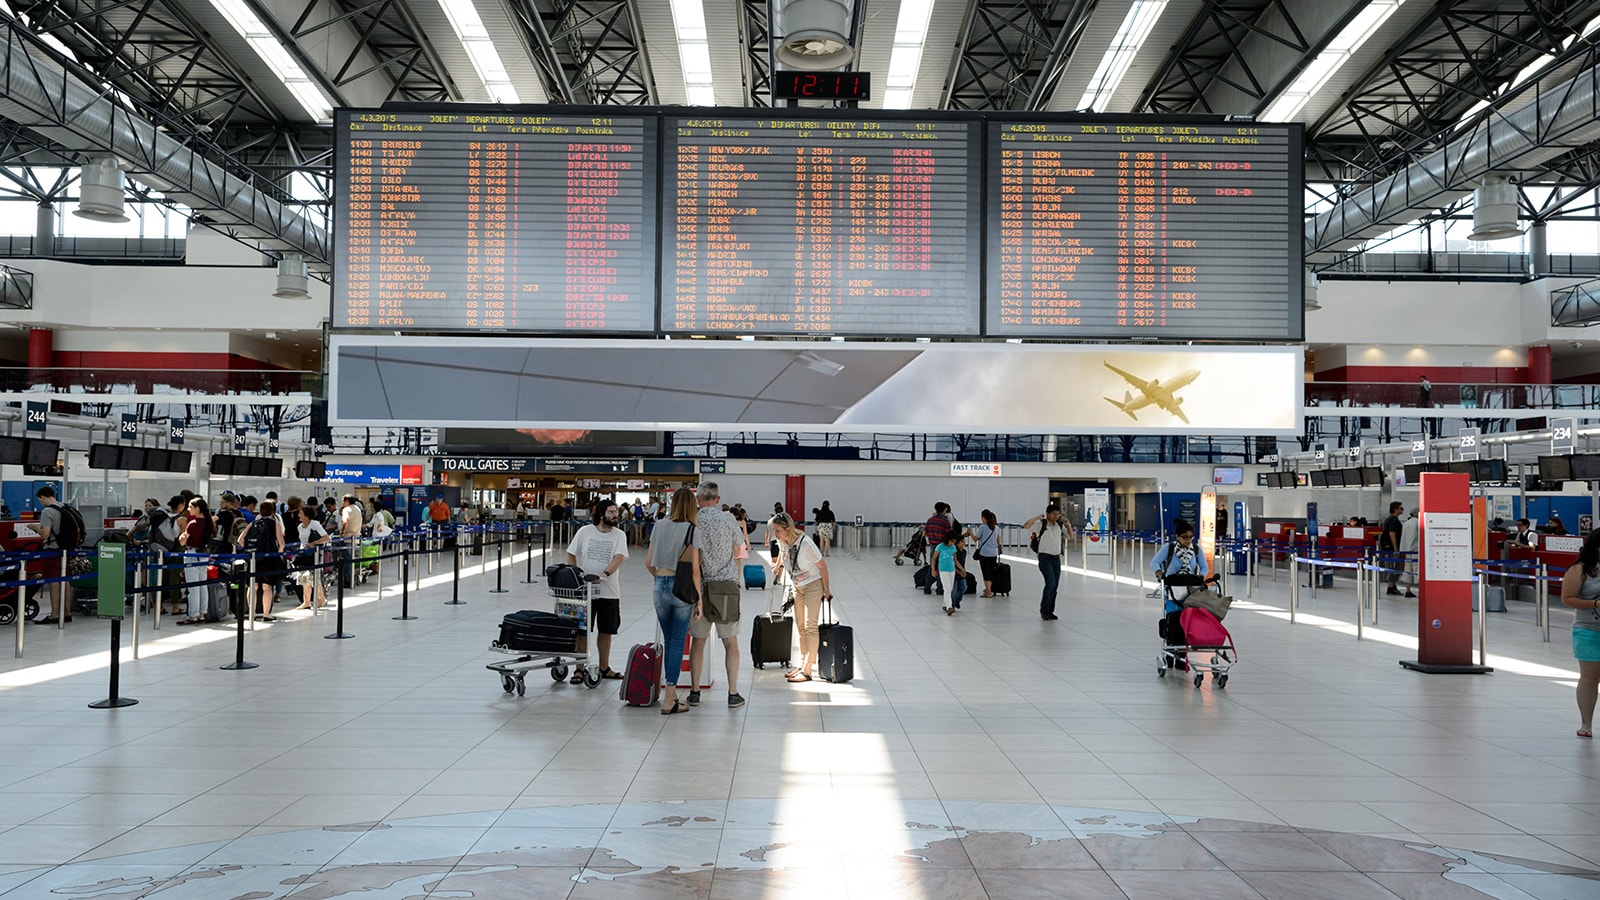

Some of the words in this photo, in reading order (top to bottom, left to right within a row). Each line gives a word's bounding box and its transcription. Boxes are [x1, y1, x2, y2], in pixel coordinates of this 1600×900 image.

[793, 75, 859, 95] 12:11
[381, 141, 422, 149] BRUSSELS
[1032, 151, 1061, 159] LISBON
[1032, 194, 1062, 202] ATHENS
[523, 284, 539, 292] 223
[28, 410, 46, 423] 244
[122, 421, 137, 433] 245
[171, 427, 184, 438] 246
[1553, 427, 1572, 440] 234
[235, 435, 245, 444] 247
[1461, 435, 1475, 447] 235
[1412, 440, 1425, 452] 236
[442, 459, 457, 470] TO
[457, 459, 477, 470] ALL
[477, 459, 509, 470] GATES
[335, 469, 363, 477] Exchange
[370, 476, 399, 484] Travelex
[100, 545, 122, 553] Economy
